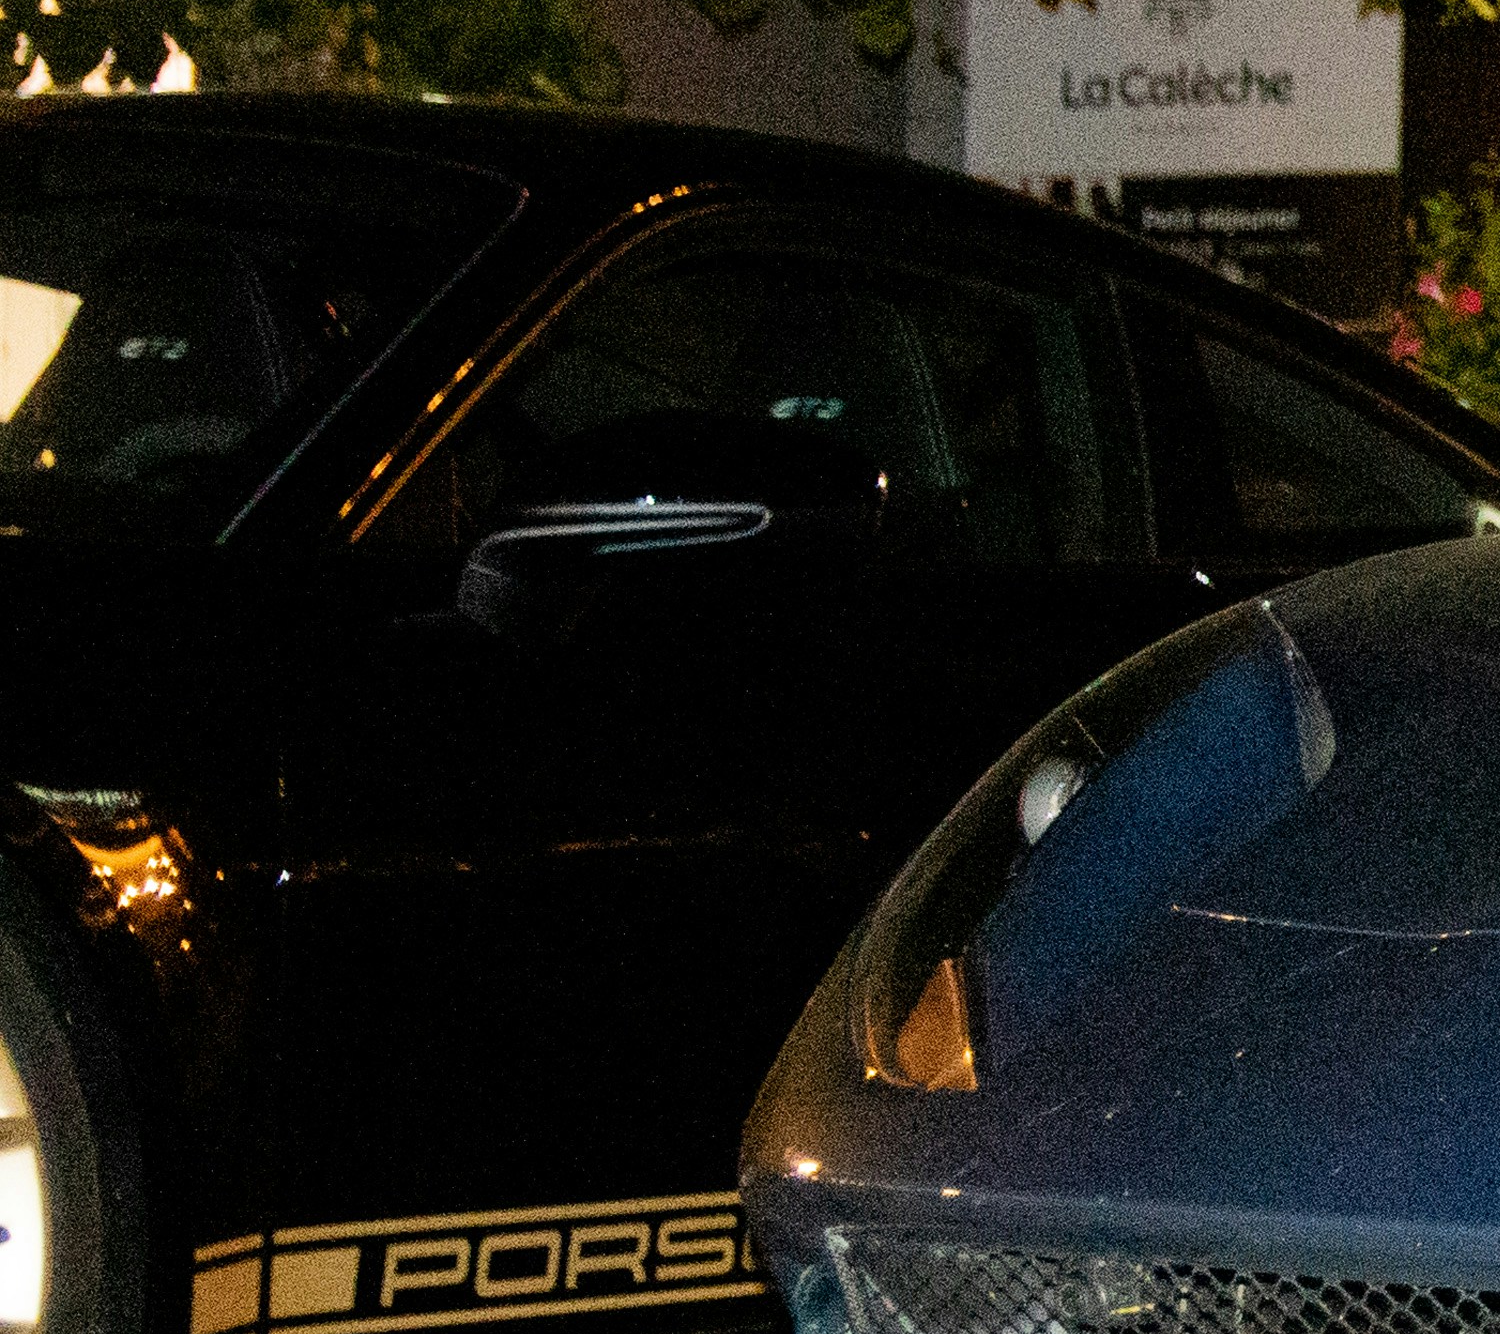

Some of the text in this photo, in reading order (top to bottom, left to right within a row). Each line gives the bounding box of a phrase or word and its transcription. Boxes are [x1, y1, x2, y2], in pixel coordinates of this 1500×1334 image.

[1060, 59, 1293, 109] La Calèche
[379, 1213, 754, 1308] PORS
